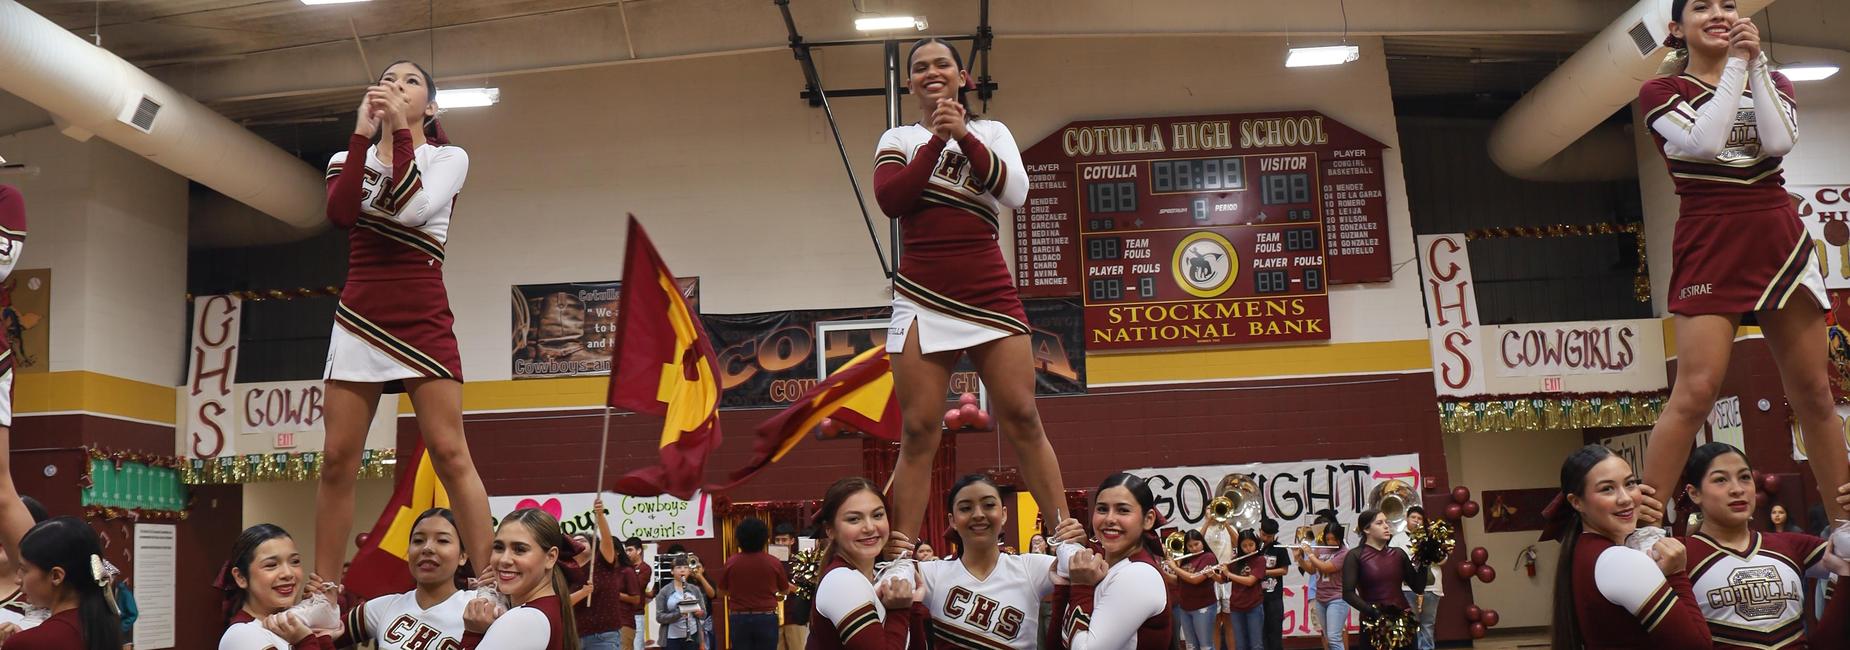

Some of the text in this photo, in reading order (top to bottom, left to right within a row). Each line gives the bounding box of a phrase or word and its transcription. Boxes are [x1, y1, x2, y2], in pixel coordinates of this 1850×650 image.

[1062, 116, 1328, 157] COTULLA HIGH SCHOOL
[1334, 149, 1366, 157] PLAYER
[1027, 164, 1059, 172] PLAYER
[1260, 157, 1307, 171] VISITOR
[1333, 160, 1365, 168] COWGIRL
[1083, 164, 1137, 179] COTULLA
[1328, 168, 1373, 176] BASKETBALL
[1029, 182, 1067, 190] SKETBALL
[1336, 183, 1364, 191] MENDEZ
[1359, 190, 1382, 198] GARZA
[1215, 203, 1238, 212] PERIOD
[1338, 199, 1366, 207] ROMERO
[1339, 207, 1362, 215] LEIJA
[1031, 213, 1067, 221] GONZALEZ
[1339, 215, 1368, 223] WILSON
[1031, 221, 1060, 229] GARCIA
[1340, 223, 1377, 231] GONZALEZ
[1257, 232, 1280, 242] TEAM
[1340, 231, 1369, 239] GUZMAN
[1032, 237, 1069, 246] MARTINEZ
[1126, 239, 1149, 248] TEAM
[1341, 239, 1379, 247] GONZALEZ
[1032, 246, 1060, 254] GARCIA
[1255, 243, 1282, 253] FOULS
[1328, 246, 1374, 256] 40 BOTELLO
[1033, 254, 1061, 262] ALDACO
[1124, 249, 1151, 259] FOULS
[1034, 262, 1058, 270] CHARO
[1253, 256, 1323, 268] PLAYER FOULS
[1089, 264, 1160, 276] PLAYER FOULS
[1034, 278, 1068, 286] SANCHEZ
[1678, 283, 1713, 300] JESIRAE
[596, 307, 612, 317] We
[1108, 299, 1305, 324] STOCKMENS
[1429, 237, 1472, 390] CHS
[594, 324, 607, 333] to
[1092, 322, 1236, 343] NATIONAL
[1248, 319, 1323, 336] BANK
[586, 338, 606, 348] and
[1502, 326, 1634, 371] COWGIRLS
[515, 359, 587, 375] Cowboys
[1544, 378, 1561, 391] EXIT
[245, 386, 325, 427] COWB
[1445, 402, 1455, 411] 10
[1474, 402, 1486, 411] 20
[1503, 400, 1514, 409] 30
[1716, 398, 1742, 430] SERVE
[277, 433, 294, 446] EXIT
[222, 458, 233, 466] 20
[249, 456, 260, 464] 30
[276, 454, 286, 463] 40
[303, 454, 314, 462] 50
[1145, 474, 1208, 524] GO
[621, 495, 688, 517] Cowboys
[621, 519, 686, 538] Cowgirls
[1706, 580, 1800, 609] COTULLA
[943, 585, 1025, 640] CHS
